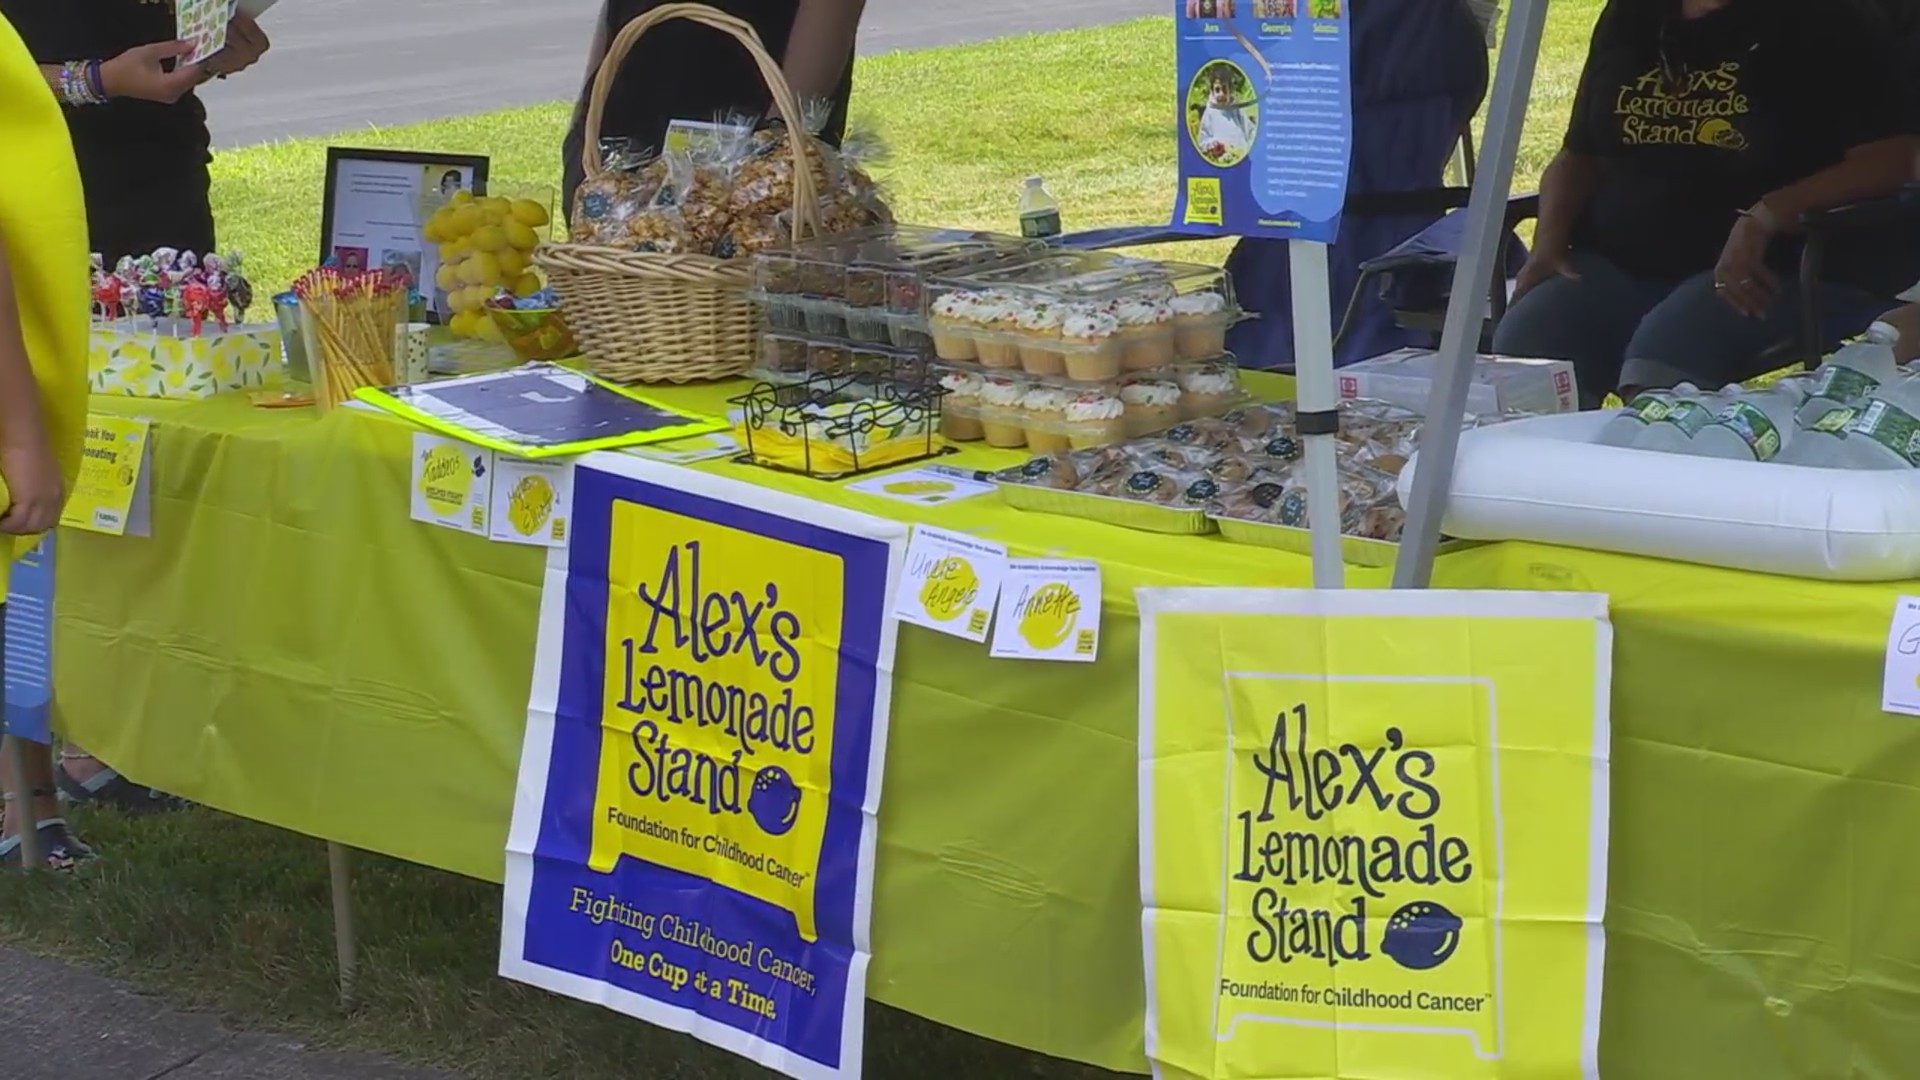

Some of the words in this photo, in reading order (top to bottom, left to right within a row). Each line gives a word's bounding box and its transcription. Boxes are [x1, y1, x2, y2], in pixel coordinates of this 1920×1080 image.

[1613, 85, 1749, 119] Lemonade
[1622, 115, 1697, 145] Stand
[638, 540, 800, 682] Alex's
[616, 638, 815, 755] Lemonade
[627, 719, 743, 815] Stand
[1253, 703, 1441, 822] Alex's
[607, 806, 678, 844] Foundation
[680, 828, 700, 849] for
[703, 834, 764, 873] Childhood
[767, 858, 806, 888] Caner
[1233, 810, 1472, 898] Lemonade
[569, 887, 655, 939] Fighting
[757, 947, 816, 996] Cancer,
[611, 939, 645, 971] One
[648, 953, 689, 991] Cup
[709, 981, 722, 999] a
[1247, 887, 1371, 967] Stand
[1219, 978, 1299, 1002] Foundation
[1301, 984, 1321, 1005] for
[1323, 987, 1412, 1010] Childhood
